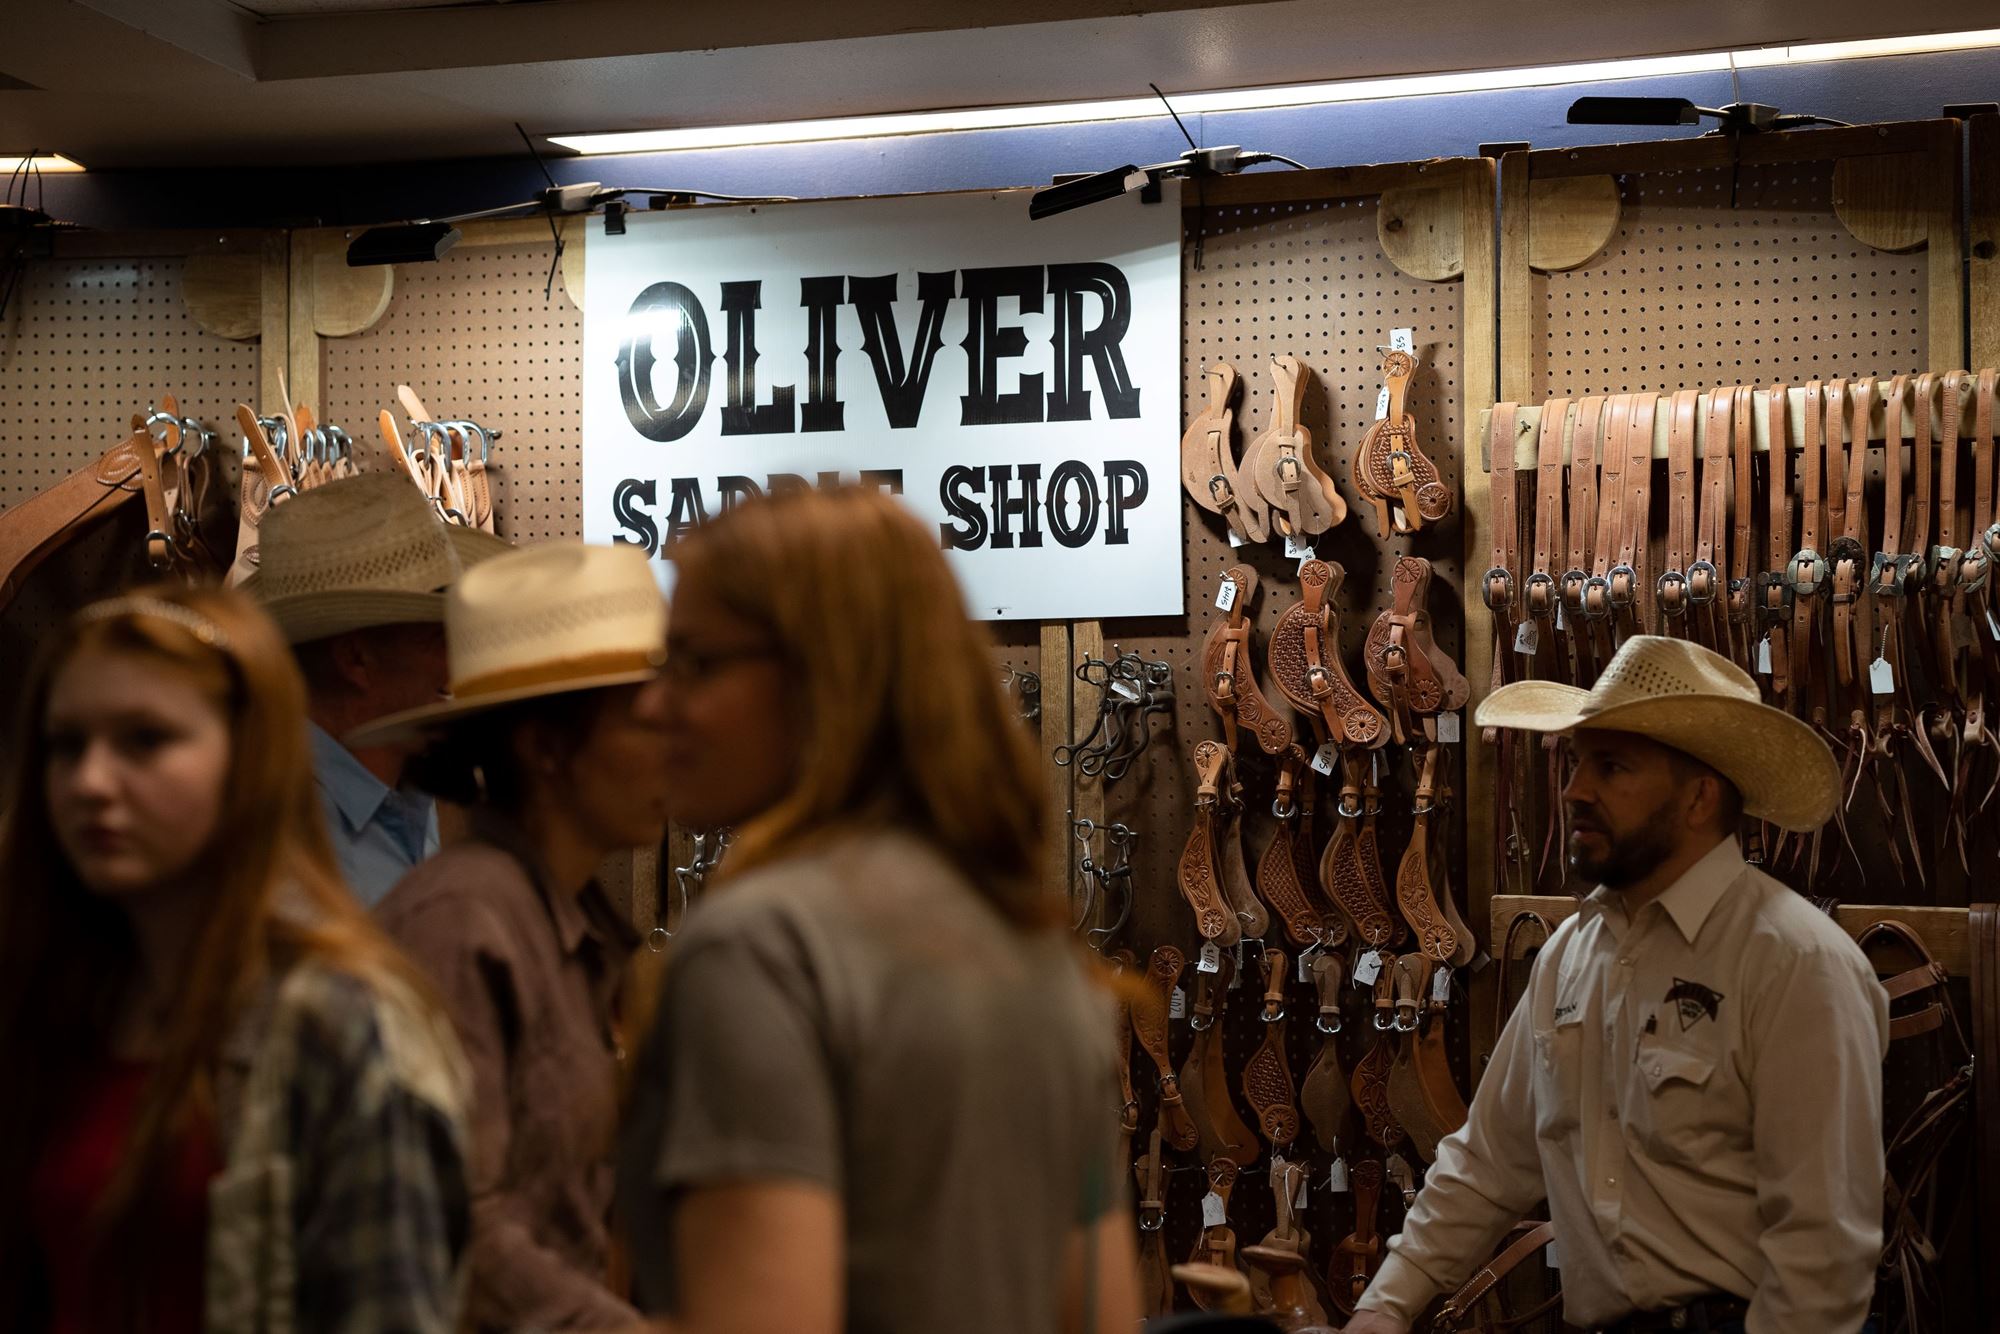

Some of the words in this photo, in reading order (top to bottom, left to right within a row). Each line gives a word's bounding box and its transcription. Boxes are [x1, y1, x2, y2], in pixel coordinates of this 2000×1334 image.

[614, 262, 1141, 443] OLIVER
[940, 460, 1150, 551] SHOP
[1221, 586, 1232, 606] $145
[1319, 750, 1332, 769] $105
[1203, 949, 1215, 969] $102
